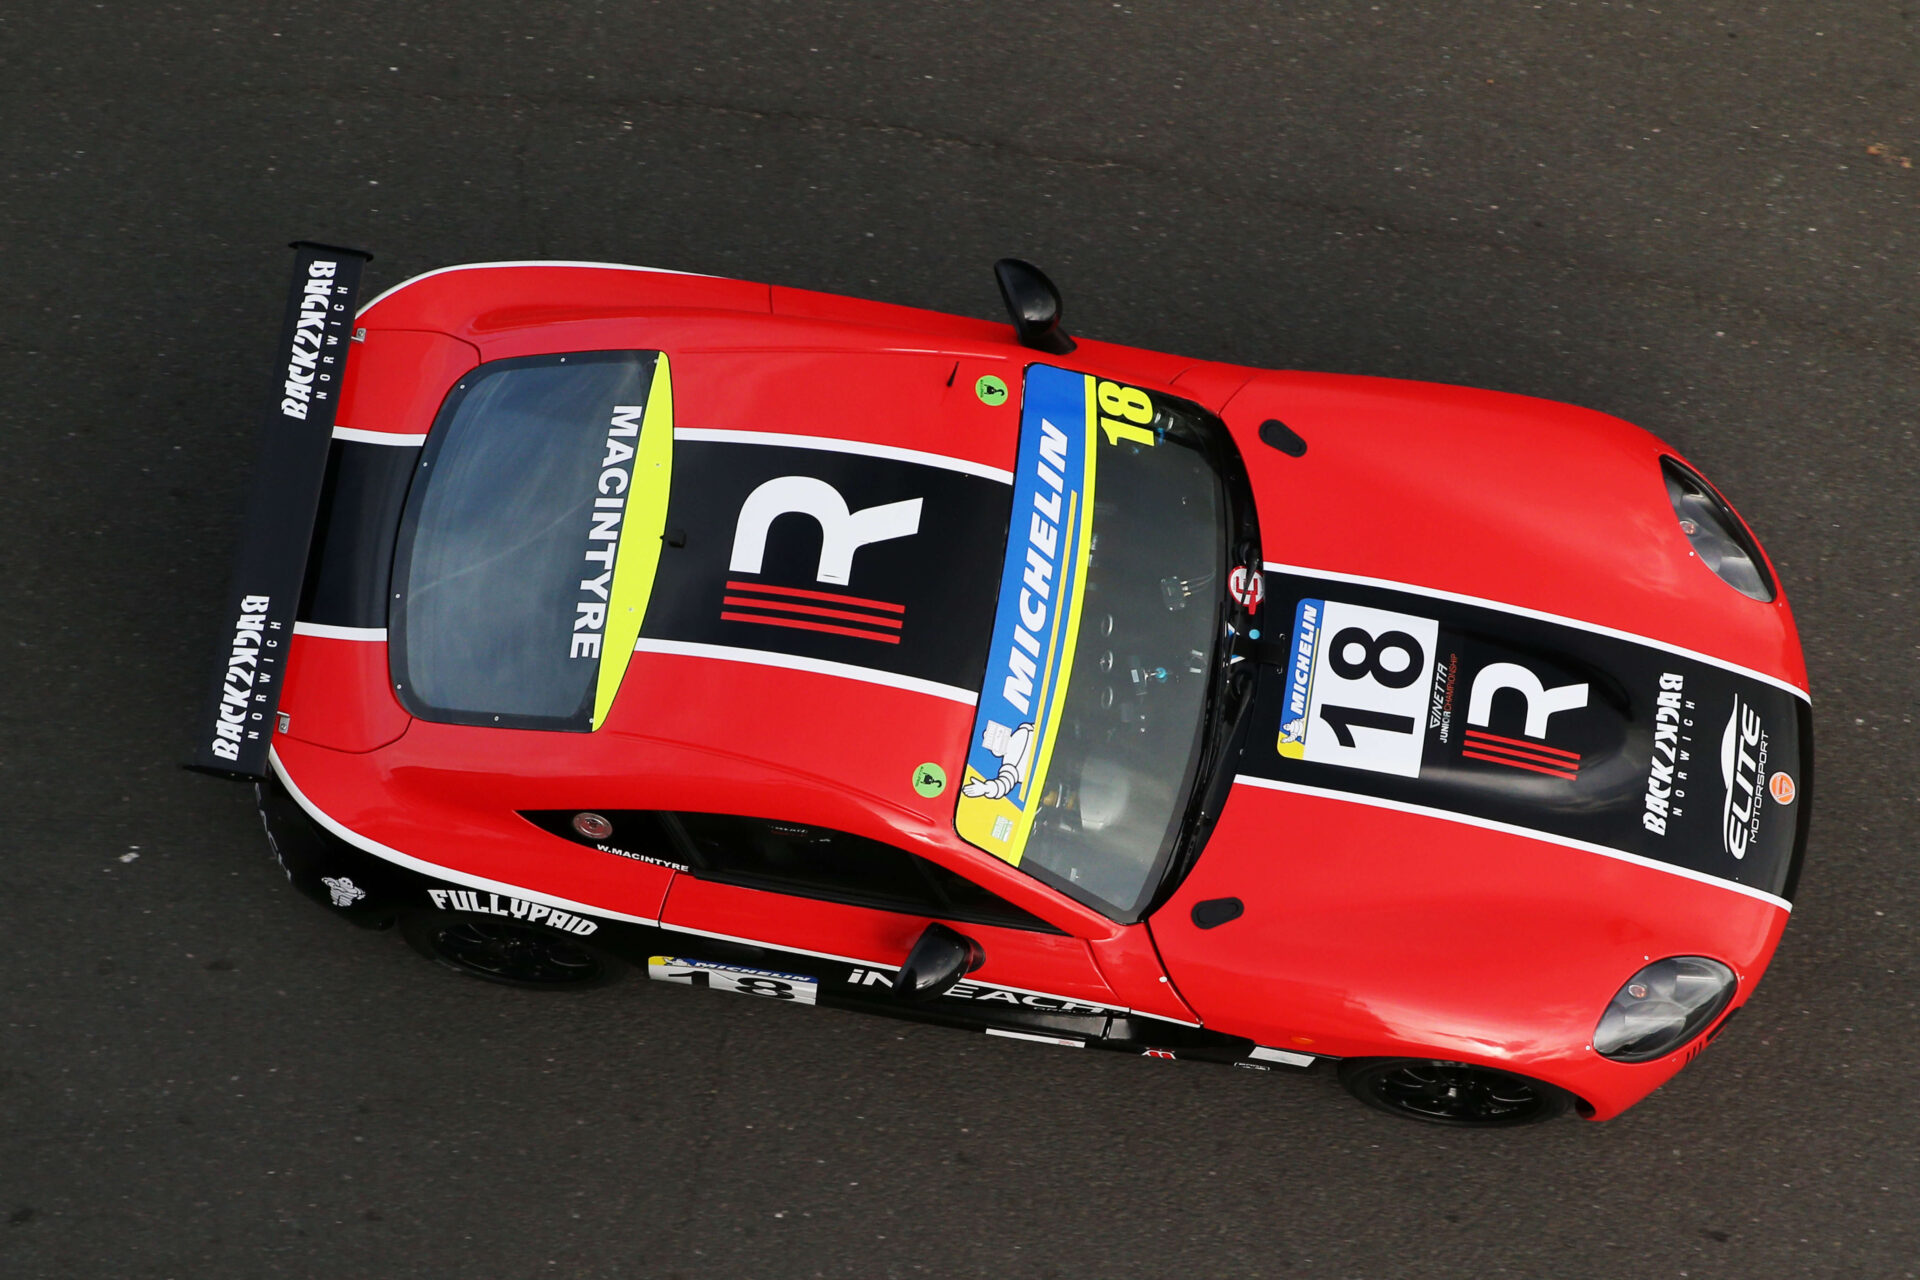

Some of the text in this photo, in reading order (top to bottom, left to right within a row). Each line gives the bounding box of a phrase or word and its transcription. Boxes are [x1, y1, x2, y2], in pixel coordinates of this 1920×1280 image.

[316, 286, 348, 400] NORWICH
[1098, 380, 1155, 447] 18
[569, 404, 643, 660] MACINTYRE
[1002, 419, 1068, 716] MICHELIN
[247, 621, 281, 740] NORWICH
[1291, 604, 1317, 716] MICHELIN
[1320, 627, 1425, 747] 18
[1430, 662, 1448, 729] GINETTA
[1672, 700, 1696, 817] NORWICH
[1730, 703, 1760, 860] ELITE
[1750, 730, 1768, 843] MOTORSPORT
[427, 889, 599, 936] FULLYPAID
[596, 844, 690, 873] W.MACINTYRE
[668, 971, 795, 1000] 18
[694, 962, 812, 982] MICHELIN
